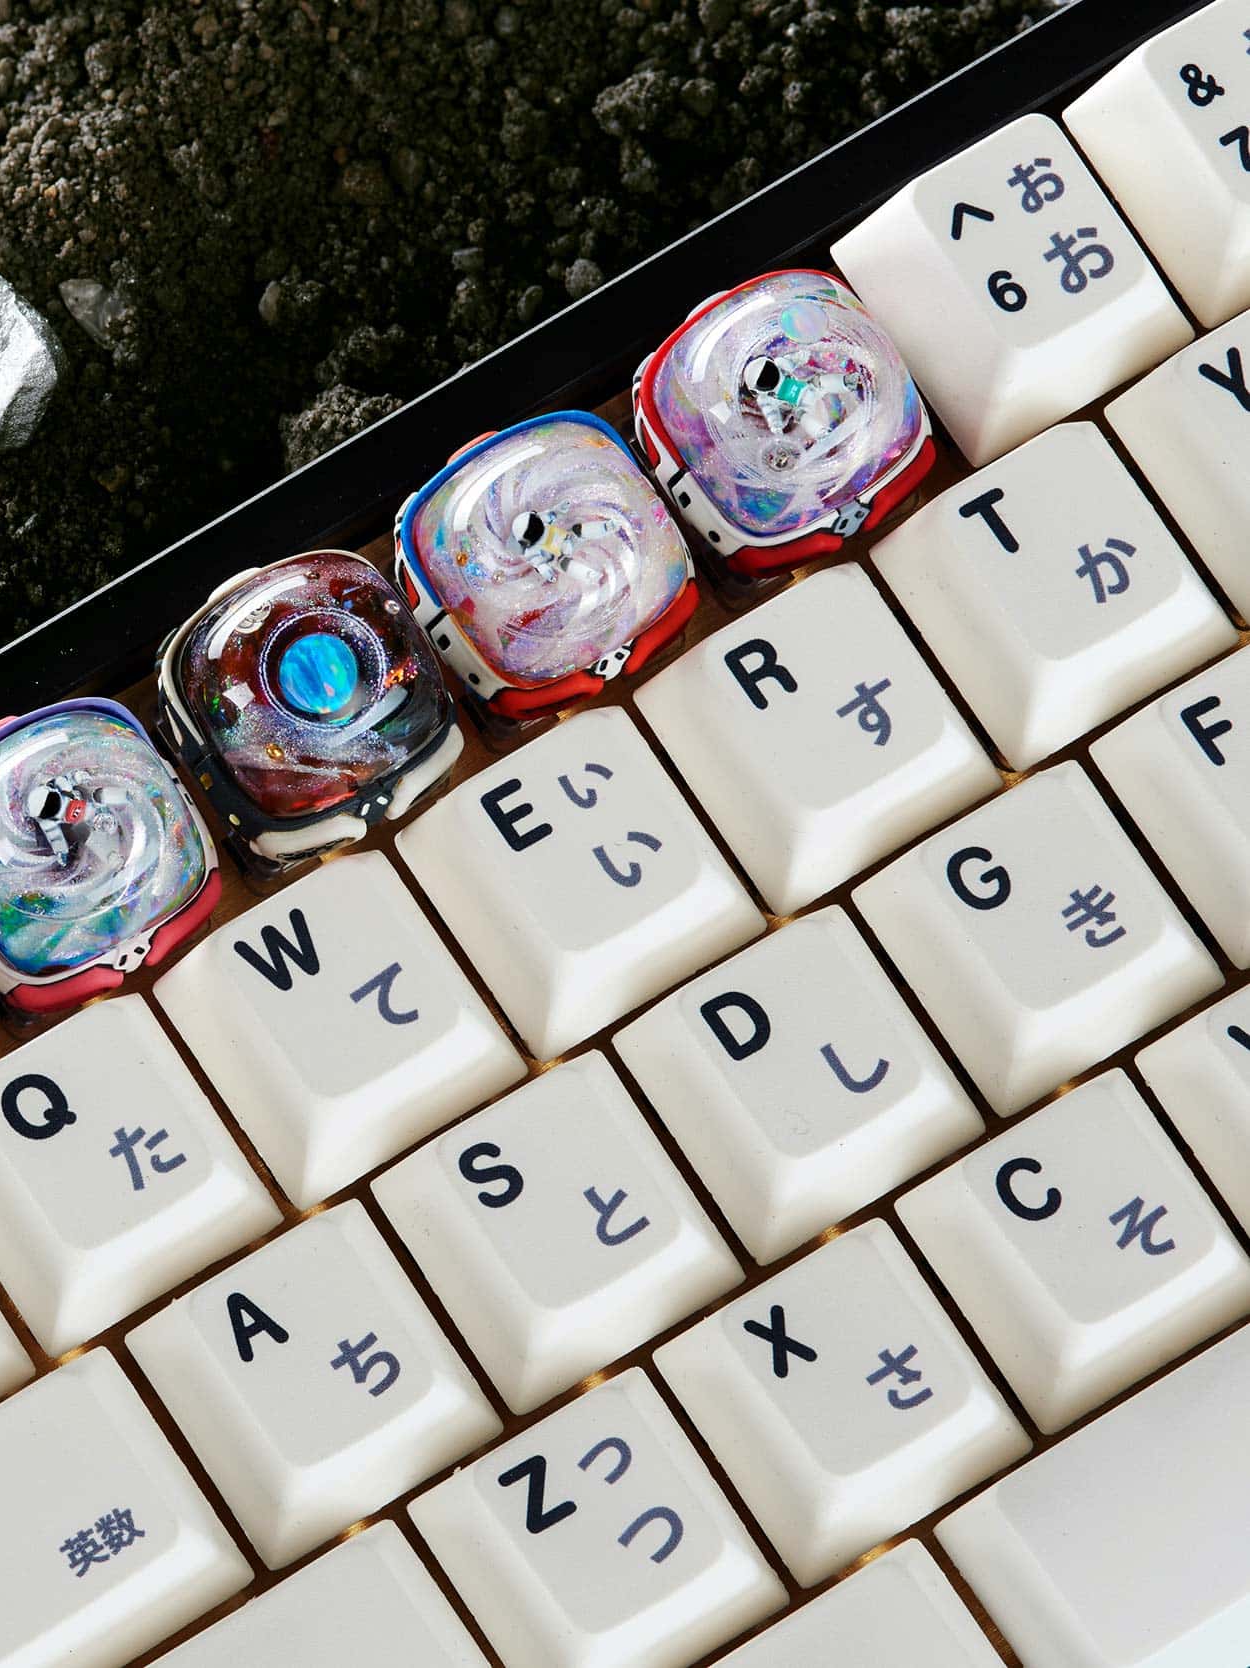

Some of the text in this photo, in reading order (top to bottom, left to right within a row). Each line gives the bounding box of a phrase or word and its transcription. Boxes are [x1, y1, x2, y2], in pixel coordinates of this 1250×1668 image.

[1178, 63, 1226, 108] &
[987, 269, 1028, 313] 6
[1042, 226, 1115, 294] お
[1197, 346, 1250, 413] Y
[958, 487, 1020, 554] T
[1075, 537, 1137, 604] か
[723, 638, 799, 711] R
[836, 678, 892, 747] す
[1179, 695, 1233, 767] F
[479, 778, 554, 853] E
[592, 831, 663, 888] い
[946, 846, 1012, 911] G
[233, 908, 321, 992] W
[1061, 884, 1127, 949] き
[349, 962, 419, 1025] て
[699, 991, 772, 1062] D
[819, 1042, 890, 1094] し
[0, 1073, 78, 1141] Q
[108, 1126, 187, 1191] た
[457, 1141, 525, 1209] S
[995, 1156, 1063, 1222] C
[582, 1186, 651, 1247] と
[1108, 1196, 1176, 1256] そ
[226, 1292, 290, 1363] A
[742, 1304, 819, 1380] X
[330, 1331, 401, 1398] ち
[865, 1344, 934, 1411] さ
[497, 1454, 578, 1535] Z
[59, 1508, 146, 1578] 英数
[617, 1506, 684, 1564] つ
